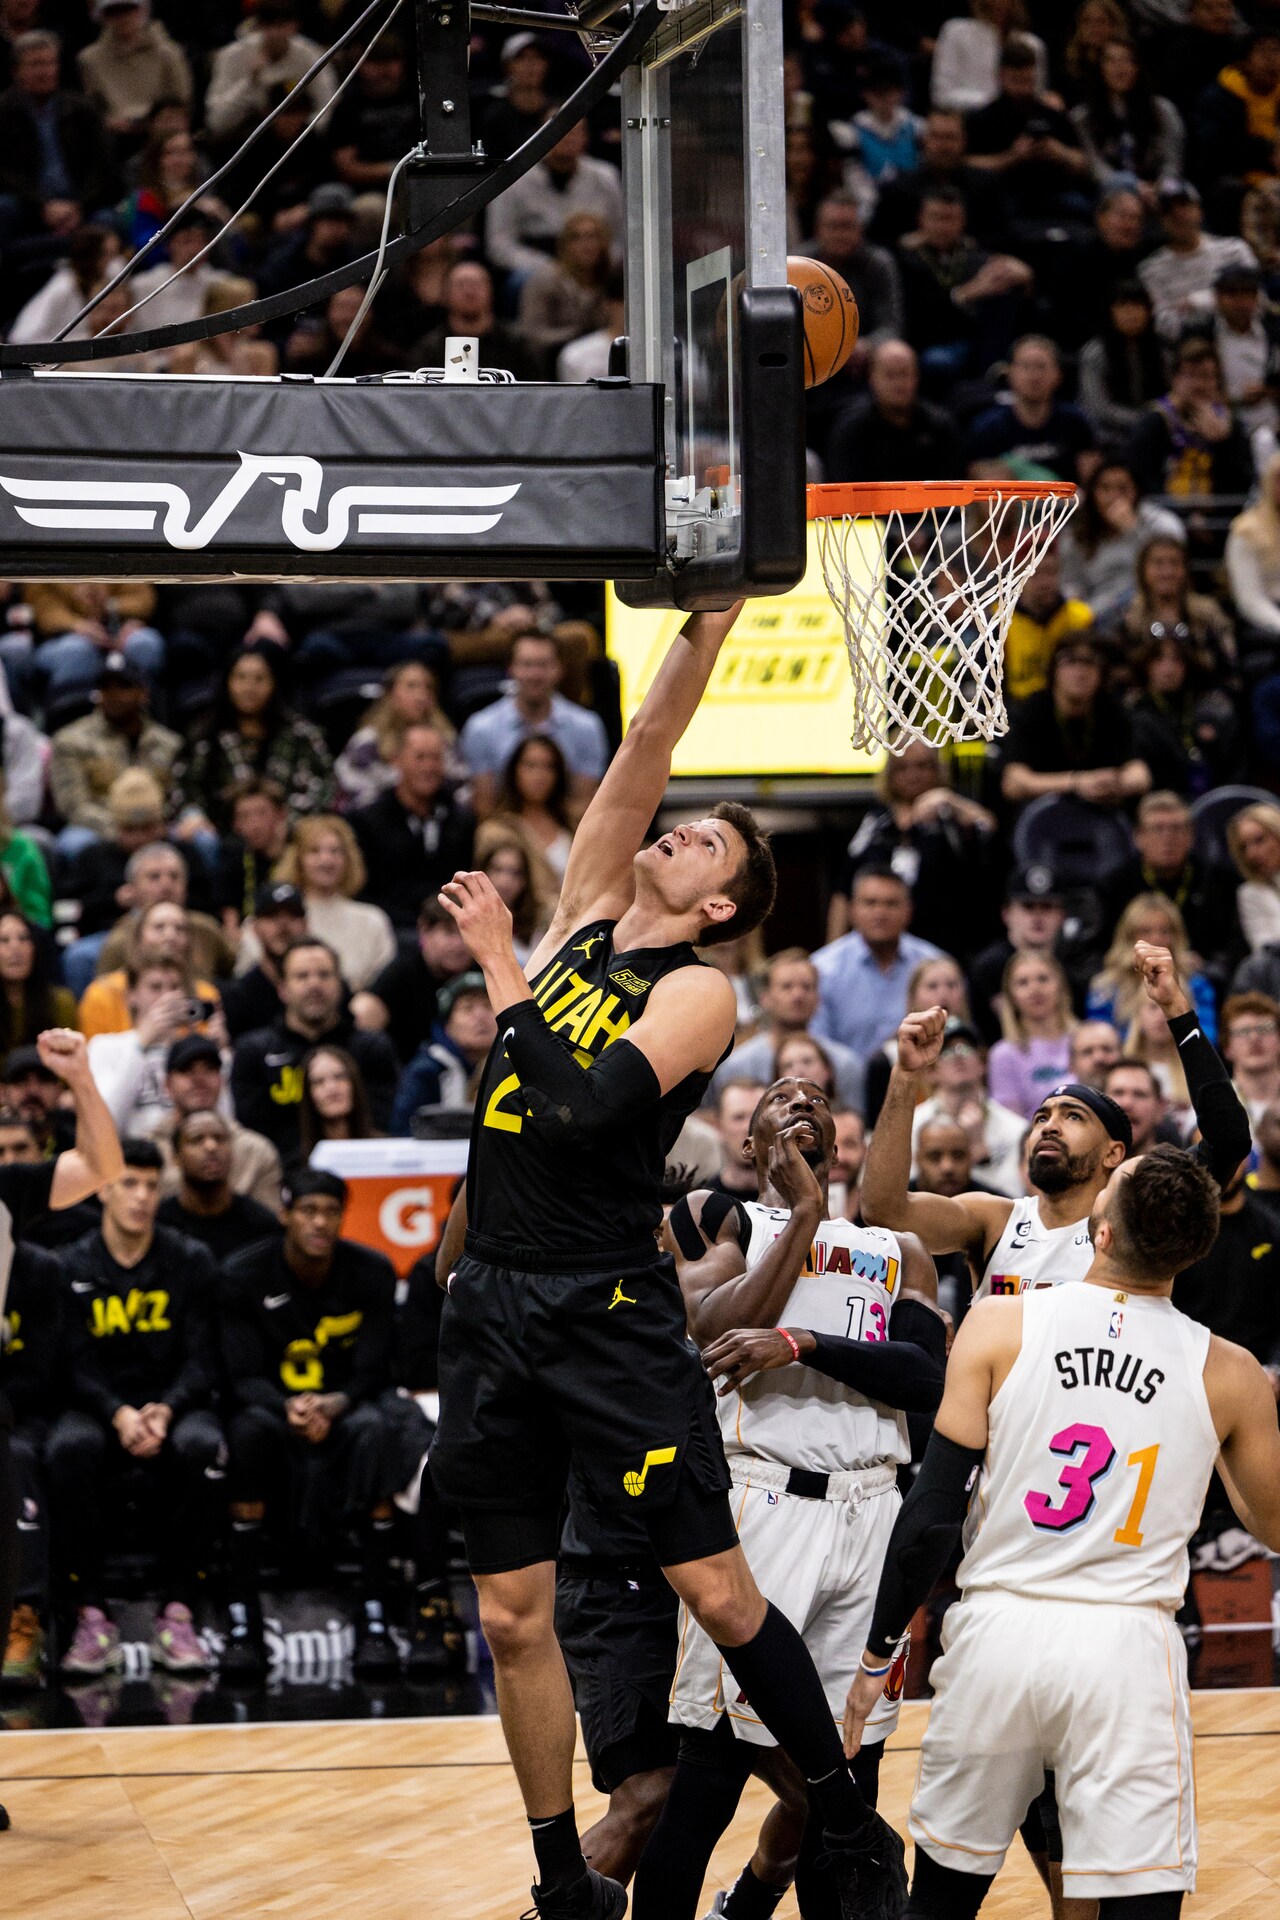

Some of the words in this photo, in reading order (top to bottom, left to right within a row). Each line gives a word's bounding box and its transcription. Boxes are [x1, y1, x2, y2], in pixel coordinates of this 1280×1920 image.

[533, 960, 631, 1051] UTAH
[379, 1187, 436, 1248] G
[847, 1296, 887, 1341] 13
[1054, 1347, 1165, 1405] STRUS
[1023, 1422, 1161, 1548] 31
